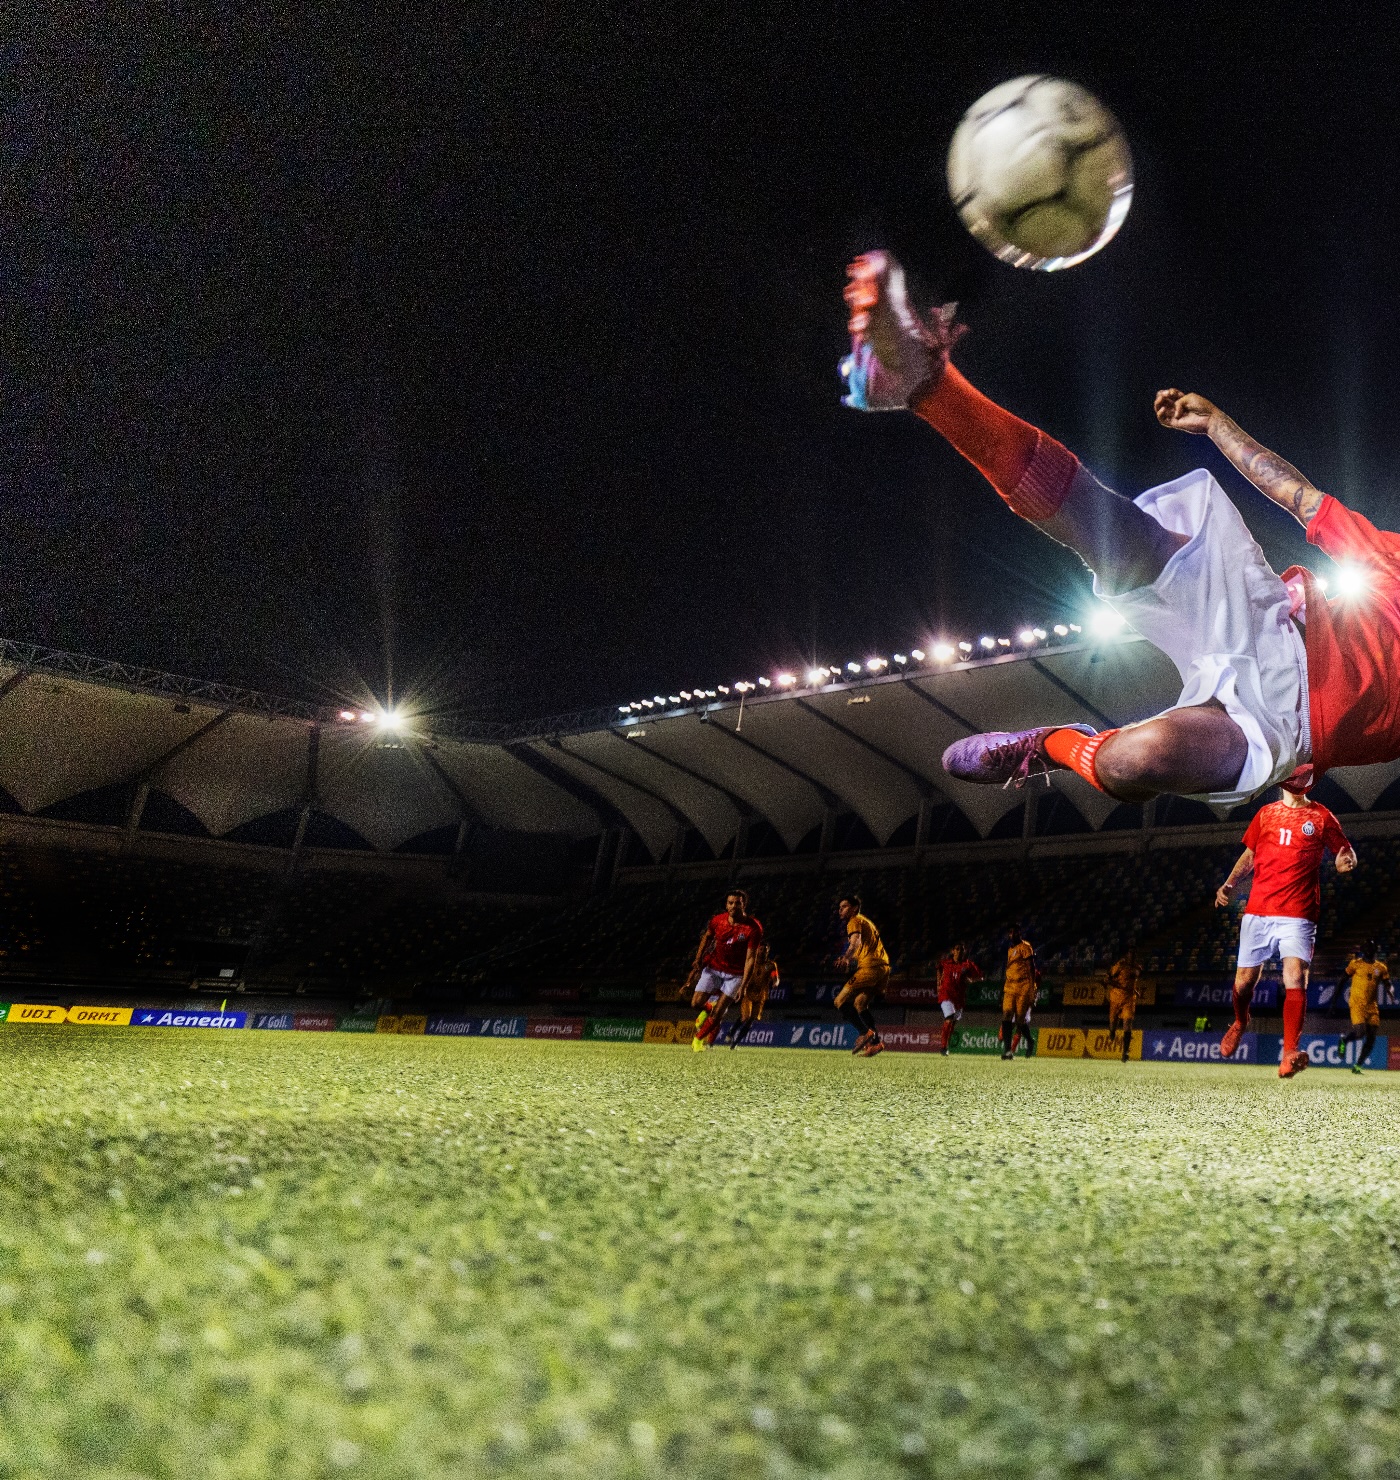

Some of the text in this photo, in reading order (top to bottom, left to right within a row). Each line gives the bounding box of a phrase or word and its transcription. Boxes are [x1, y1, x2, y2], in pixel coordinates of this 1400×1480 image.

[1280, 828, 1292, 846] 11
[1072, 987, 1096, 1000] UDI
[21, 1009, 120, 1022] UDI ORMI
[156, 1012, 237, 1028] Aenean
[434, 1020, 471, 1035] Aenean
[492, 1020, 519, 1036] Goll.
[808, 1025, 848, 1047] Goll.
[1046, 1034, 1075, 1051] UDI
[1168, 1037, 1249, 1061] Aenen
